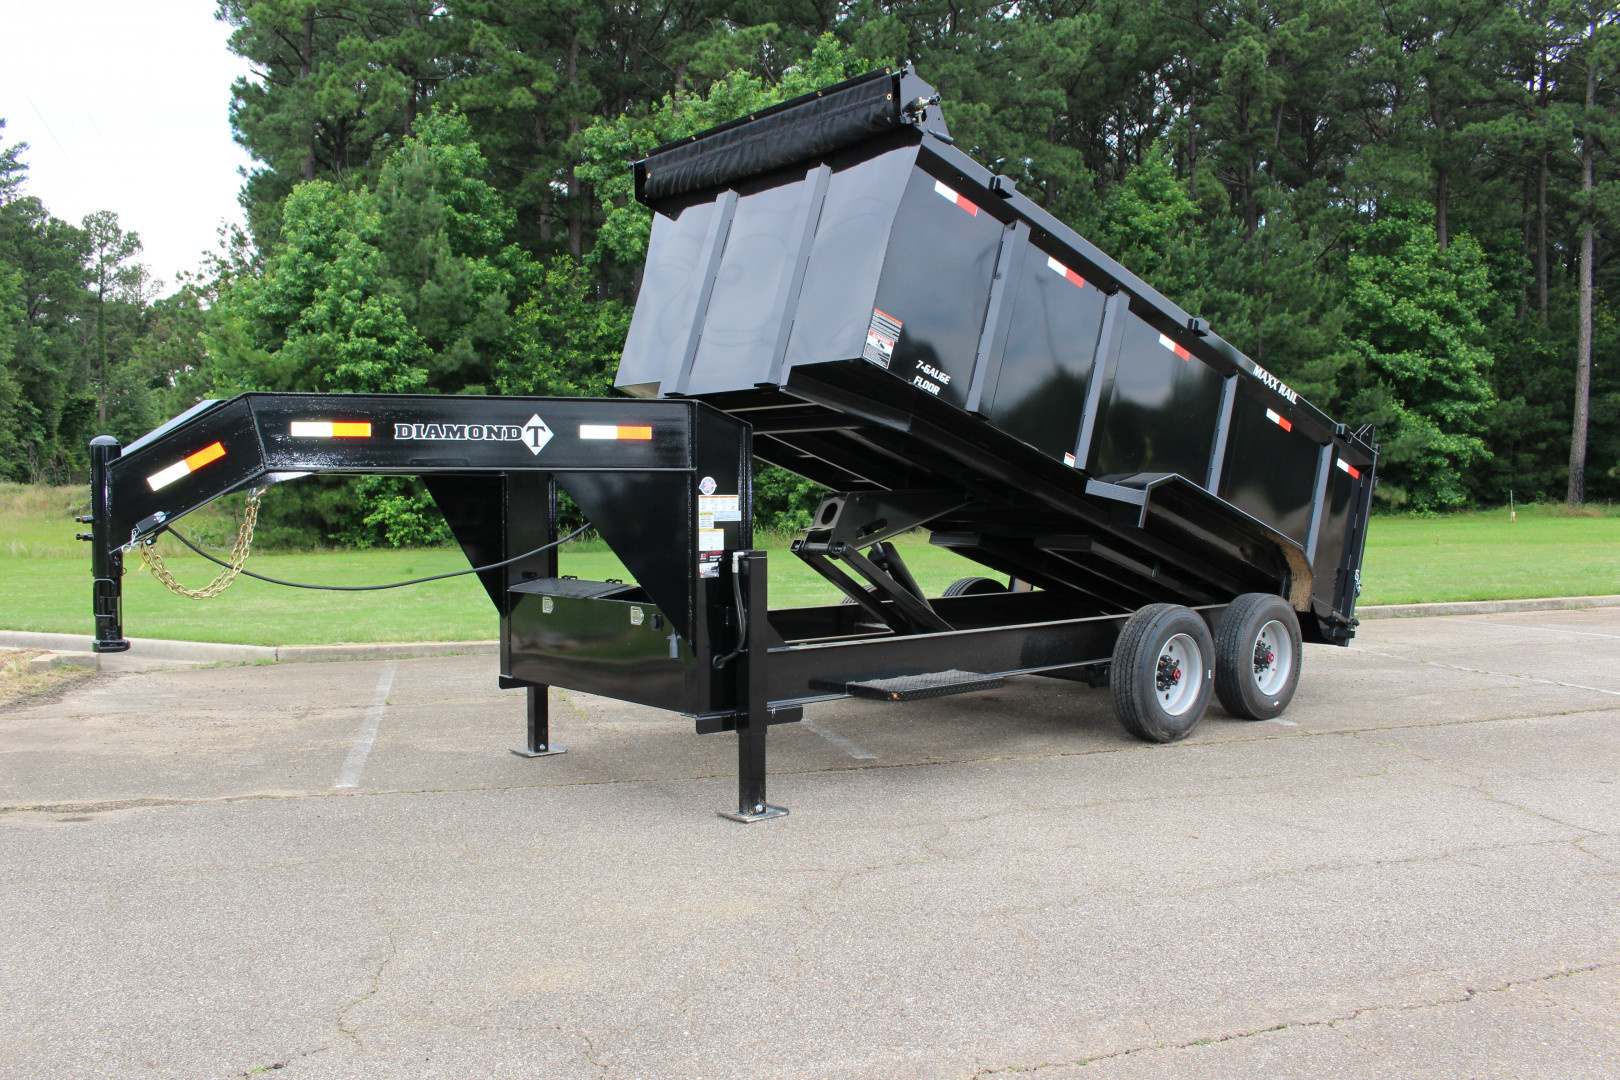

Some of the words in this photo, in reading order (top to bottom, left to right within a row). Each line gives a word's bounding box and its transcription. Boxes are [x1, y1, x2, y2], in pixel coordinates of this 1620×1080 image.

[913, 375, 940, 395] FLOOR
[915, 360, 951, 385] 7-GAUGE
[1252, 364, 1280, 391] MAXX
[1278, 382, 1298, 405] RAIL
[394, 423, 522, 441] DIAMOND
[526, 425, 547, 448] T
